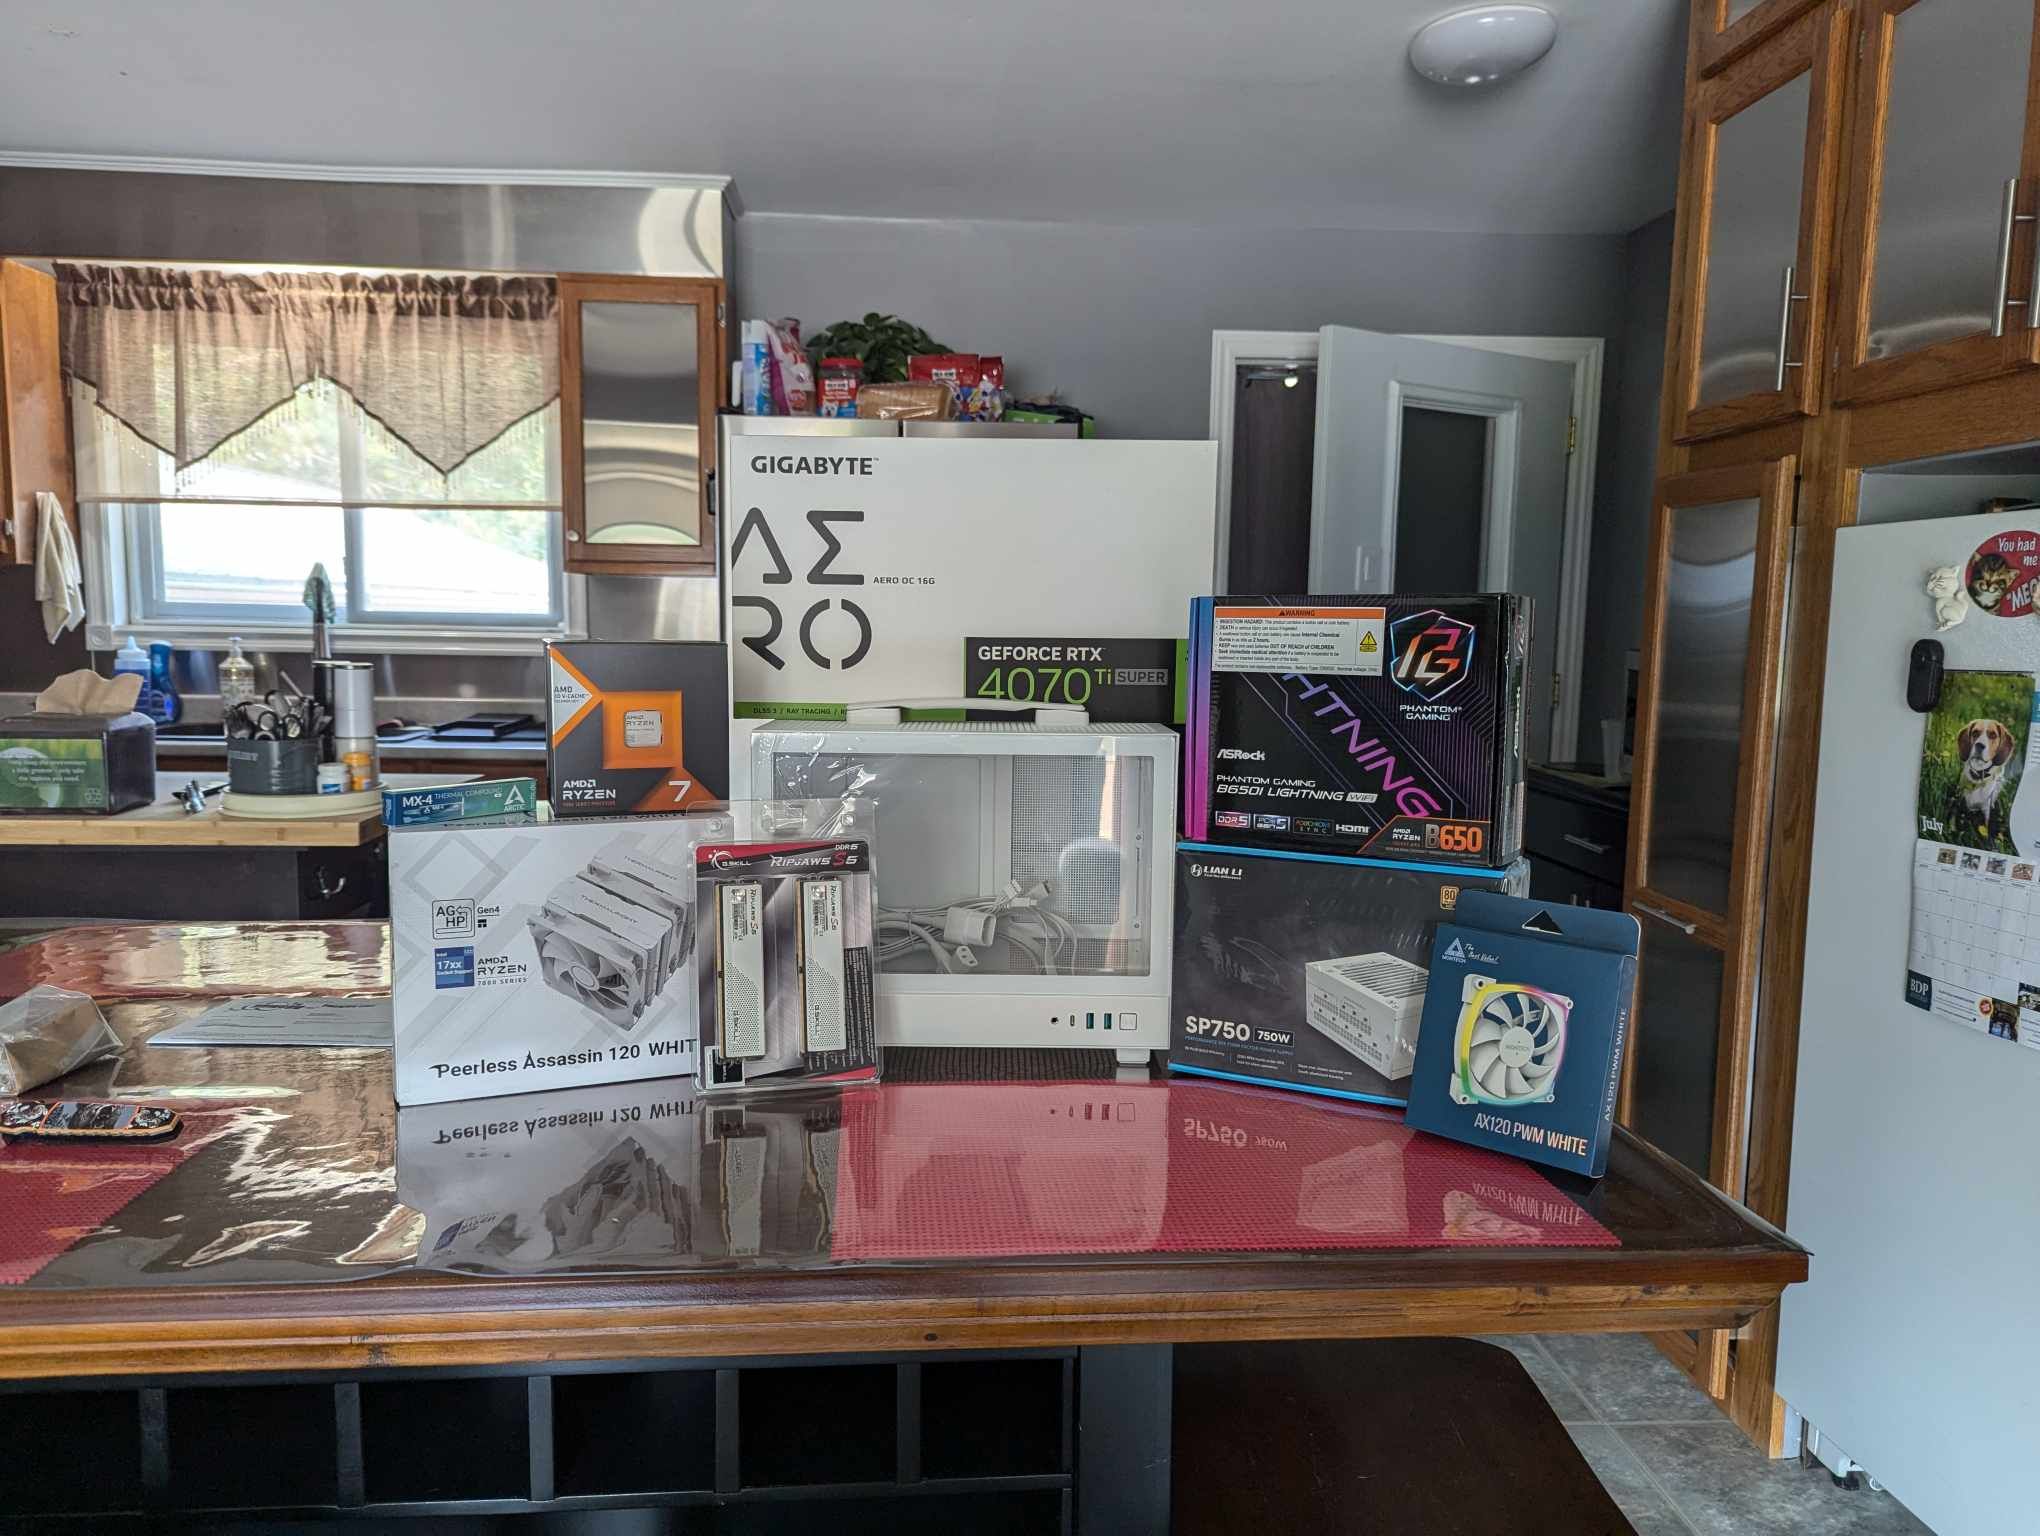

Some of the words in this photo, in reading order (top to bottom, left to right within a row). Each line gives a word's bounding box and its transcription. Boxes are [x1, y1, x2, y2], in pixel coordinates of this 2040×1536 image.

[750, 455, 873, 476] GIGABYTE
[1999, 537, 2015, 552] You
[2016, 536, 2037, 551] had
[2023, 555, 2038, 566] me
[873, 576, 898, 585] AERO
[901, 577, 914, 585] OC
[917, 577, 935, 585] 16G
[978, 646, 1061, 661] GEFORCE
[1066, 647, 1102, 661] RTX
[976, 667, 1092, 705] 4070
[1094, 668, 1112, 685] Ti
[1116, 671, 1166, 683] SUPER
[1399, 704, 1458, 713] PHANTOM
[1405, 713, 1451, 721] GAMING
[1216, 748, 1266, 761] ASRock
[562, 780, 587, 788] AMD
[1216, 774, 1270, 785] PHANTOM
[1272, 778, 1316, 788] GAMING
[434, 791, 464, 800] THERMAL
[562, 789, 617, 800] RYZEN
[668, 780, 692, 802] 7
[1216, 784, 1264, 795] B650I
[1267, 787, 1345, 801] LIGHTNING
[402, 795, 433, 808] MX-4
[503, 804, 525, 813] ARCTIC
[1920, 815, 1944, 834] July
[1392, 833, 1421, 841] RYZEN
[1425, 824, 1483, 852] B650
[1203, 865, 1229, 875] LIAN
[1231, 868, 1242, 876] LI
[1444, 889, 1456, 901] 80
[477, 906, 500, 914] Gen4
[477, 957, 500, 965] AMD
[1441, 954, 1467, 963] MONTECH
[477, 964, 527, 976] RYZEN
[500, 977, 528, 985] SERIES
[1184, 1015, 1250, 1041] SP750
[1256, 1030, 1291, 1044] 750W
[428, 1059, 518, 1079] Peerless
[522, 1050, 603, 1070] Assassin
[608, 1044, 640, 1061] 120
[648, 1038, 698, 1057] WHIT
[1474, 1112, 1511, 1136] AX120
[1513, 1122, 1545, 1145] PWM
[1547, 1130, 1588, 1157] WHITE
